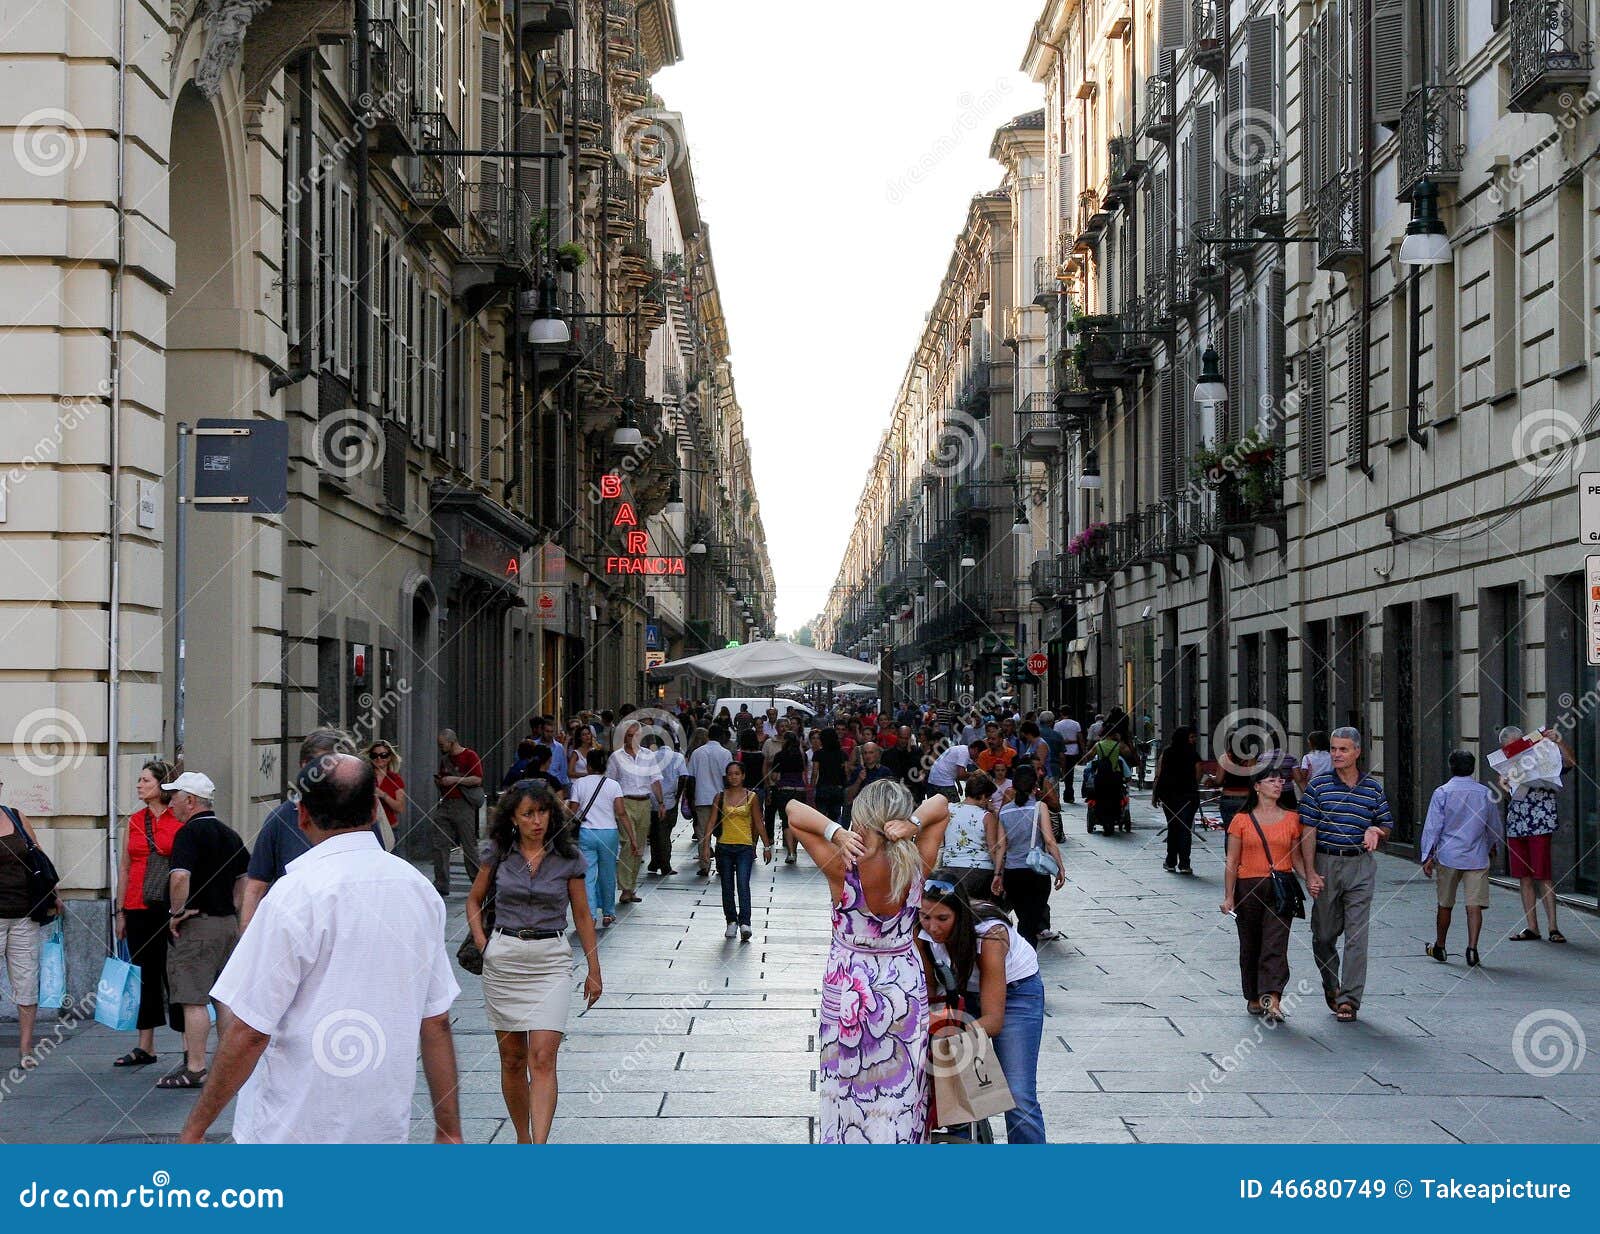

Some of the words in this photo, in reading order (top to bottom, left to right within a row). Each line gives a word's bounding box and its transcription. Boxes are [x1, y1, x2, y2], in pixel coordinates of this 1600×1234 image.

[601, 475, 648, 554] BAR
[607, 557, 686, 574] FRANCIA
[1029, 660, 1047, 669] STOP
